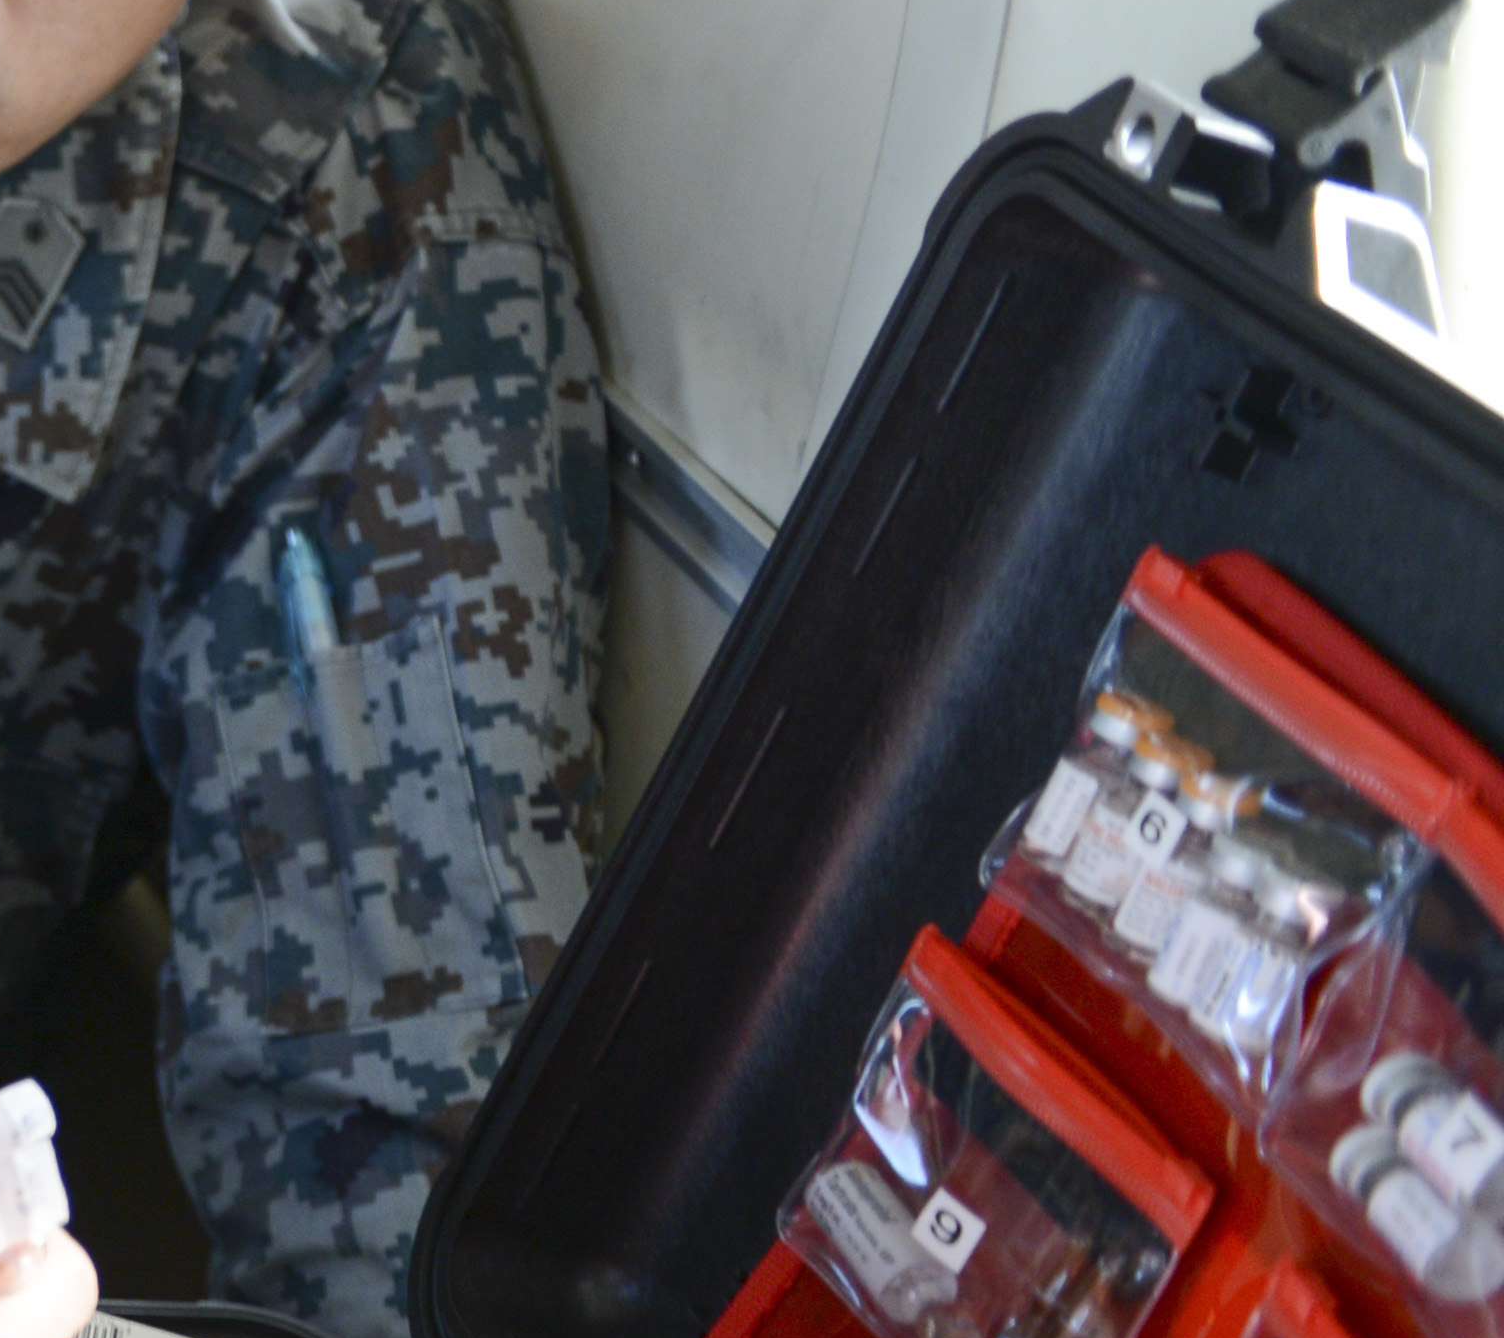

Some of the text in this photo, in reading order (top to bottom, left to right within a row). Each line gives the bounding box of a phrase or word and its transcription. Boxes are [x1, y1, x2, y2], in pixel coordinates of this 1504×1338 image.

[1139, 809, 1167, 845] 6
[1450, 1114, 1486, 1150] 7
[929, 1209, 963, 1245] 9
